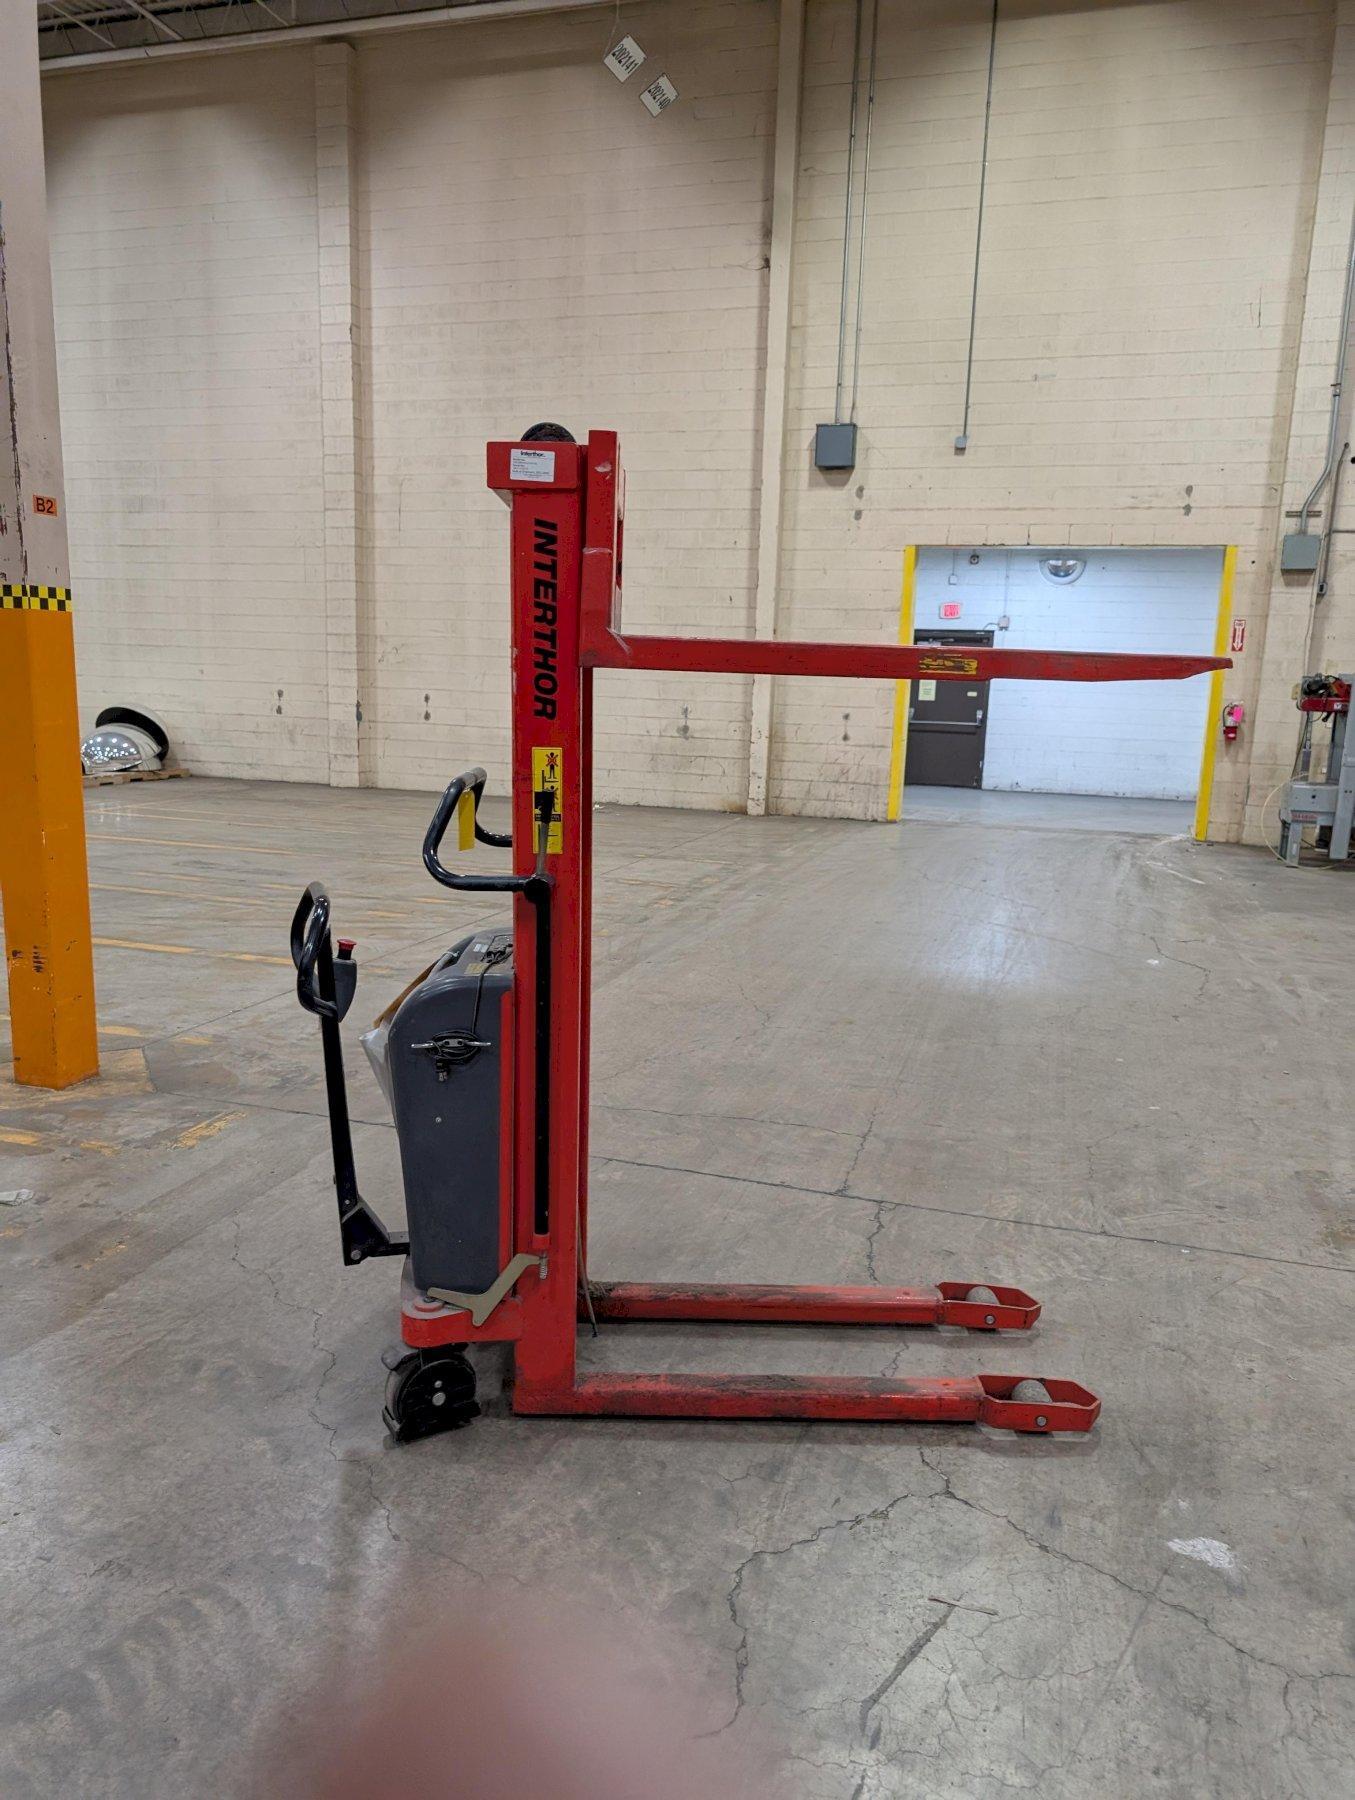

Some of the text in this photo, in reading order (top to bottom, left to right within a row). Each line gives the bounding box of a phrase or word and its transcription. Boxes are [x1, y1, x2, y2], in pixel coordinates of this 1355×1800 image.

[611, 43, 639, 74] 202141
[647, 82, 672, 110] 202140
[35, 497, 55, 514] B2
[533, 517, 558, 721] INTERTHOR
